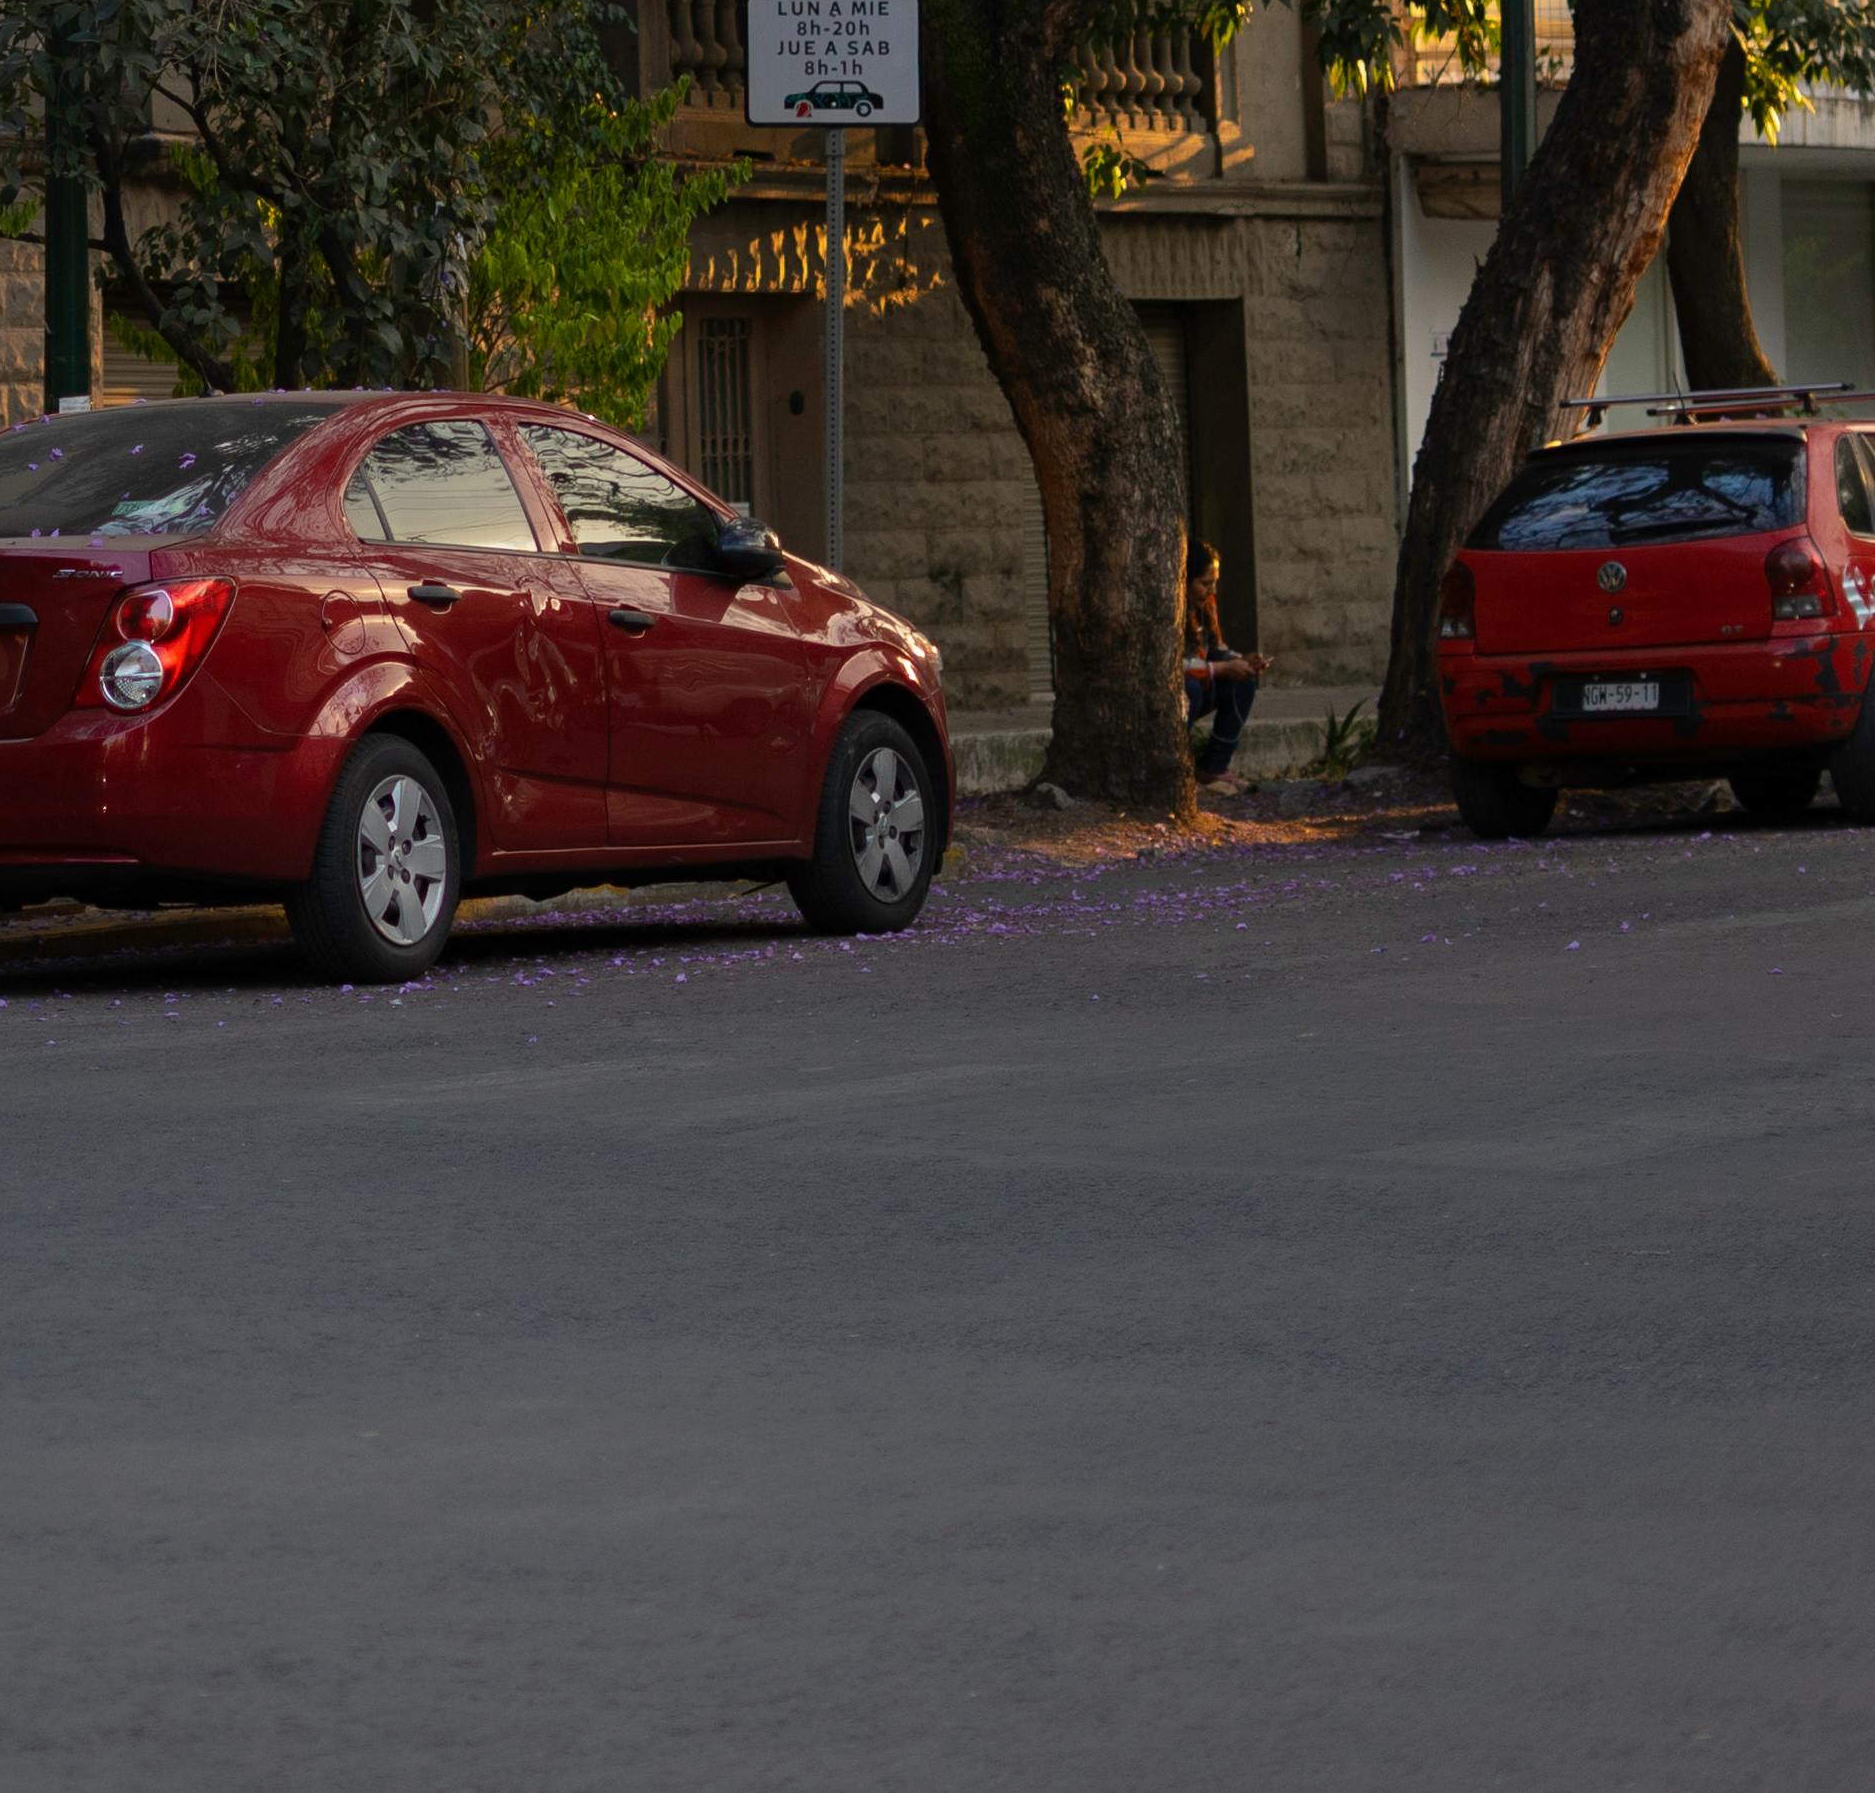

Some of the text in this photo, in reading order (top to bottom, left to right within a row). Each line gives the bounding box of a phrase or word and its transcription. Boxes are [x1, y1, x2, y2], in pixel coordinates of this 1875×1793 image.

[777, 1, 890, 16] LUN A MIE
[796, 19, 870, 36] 8h-20h
[776, 40, 891, 56] JUE A SAB
[804, 59, 863, 76] 8h-1h
